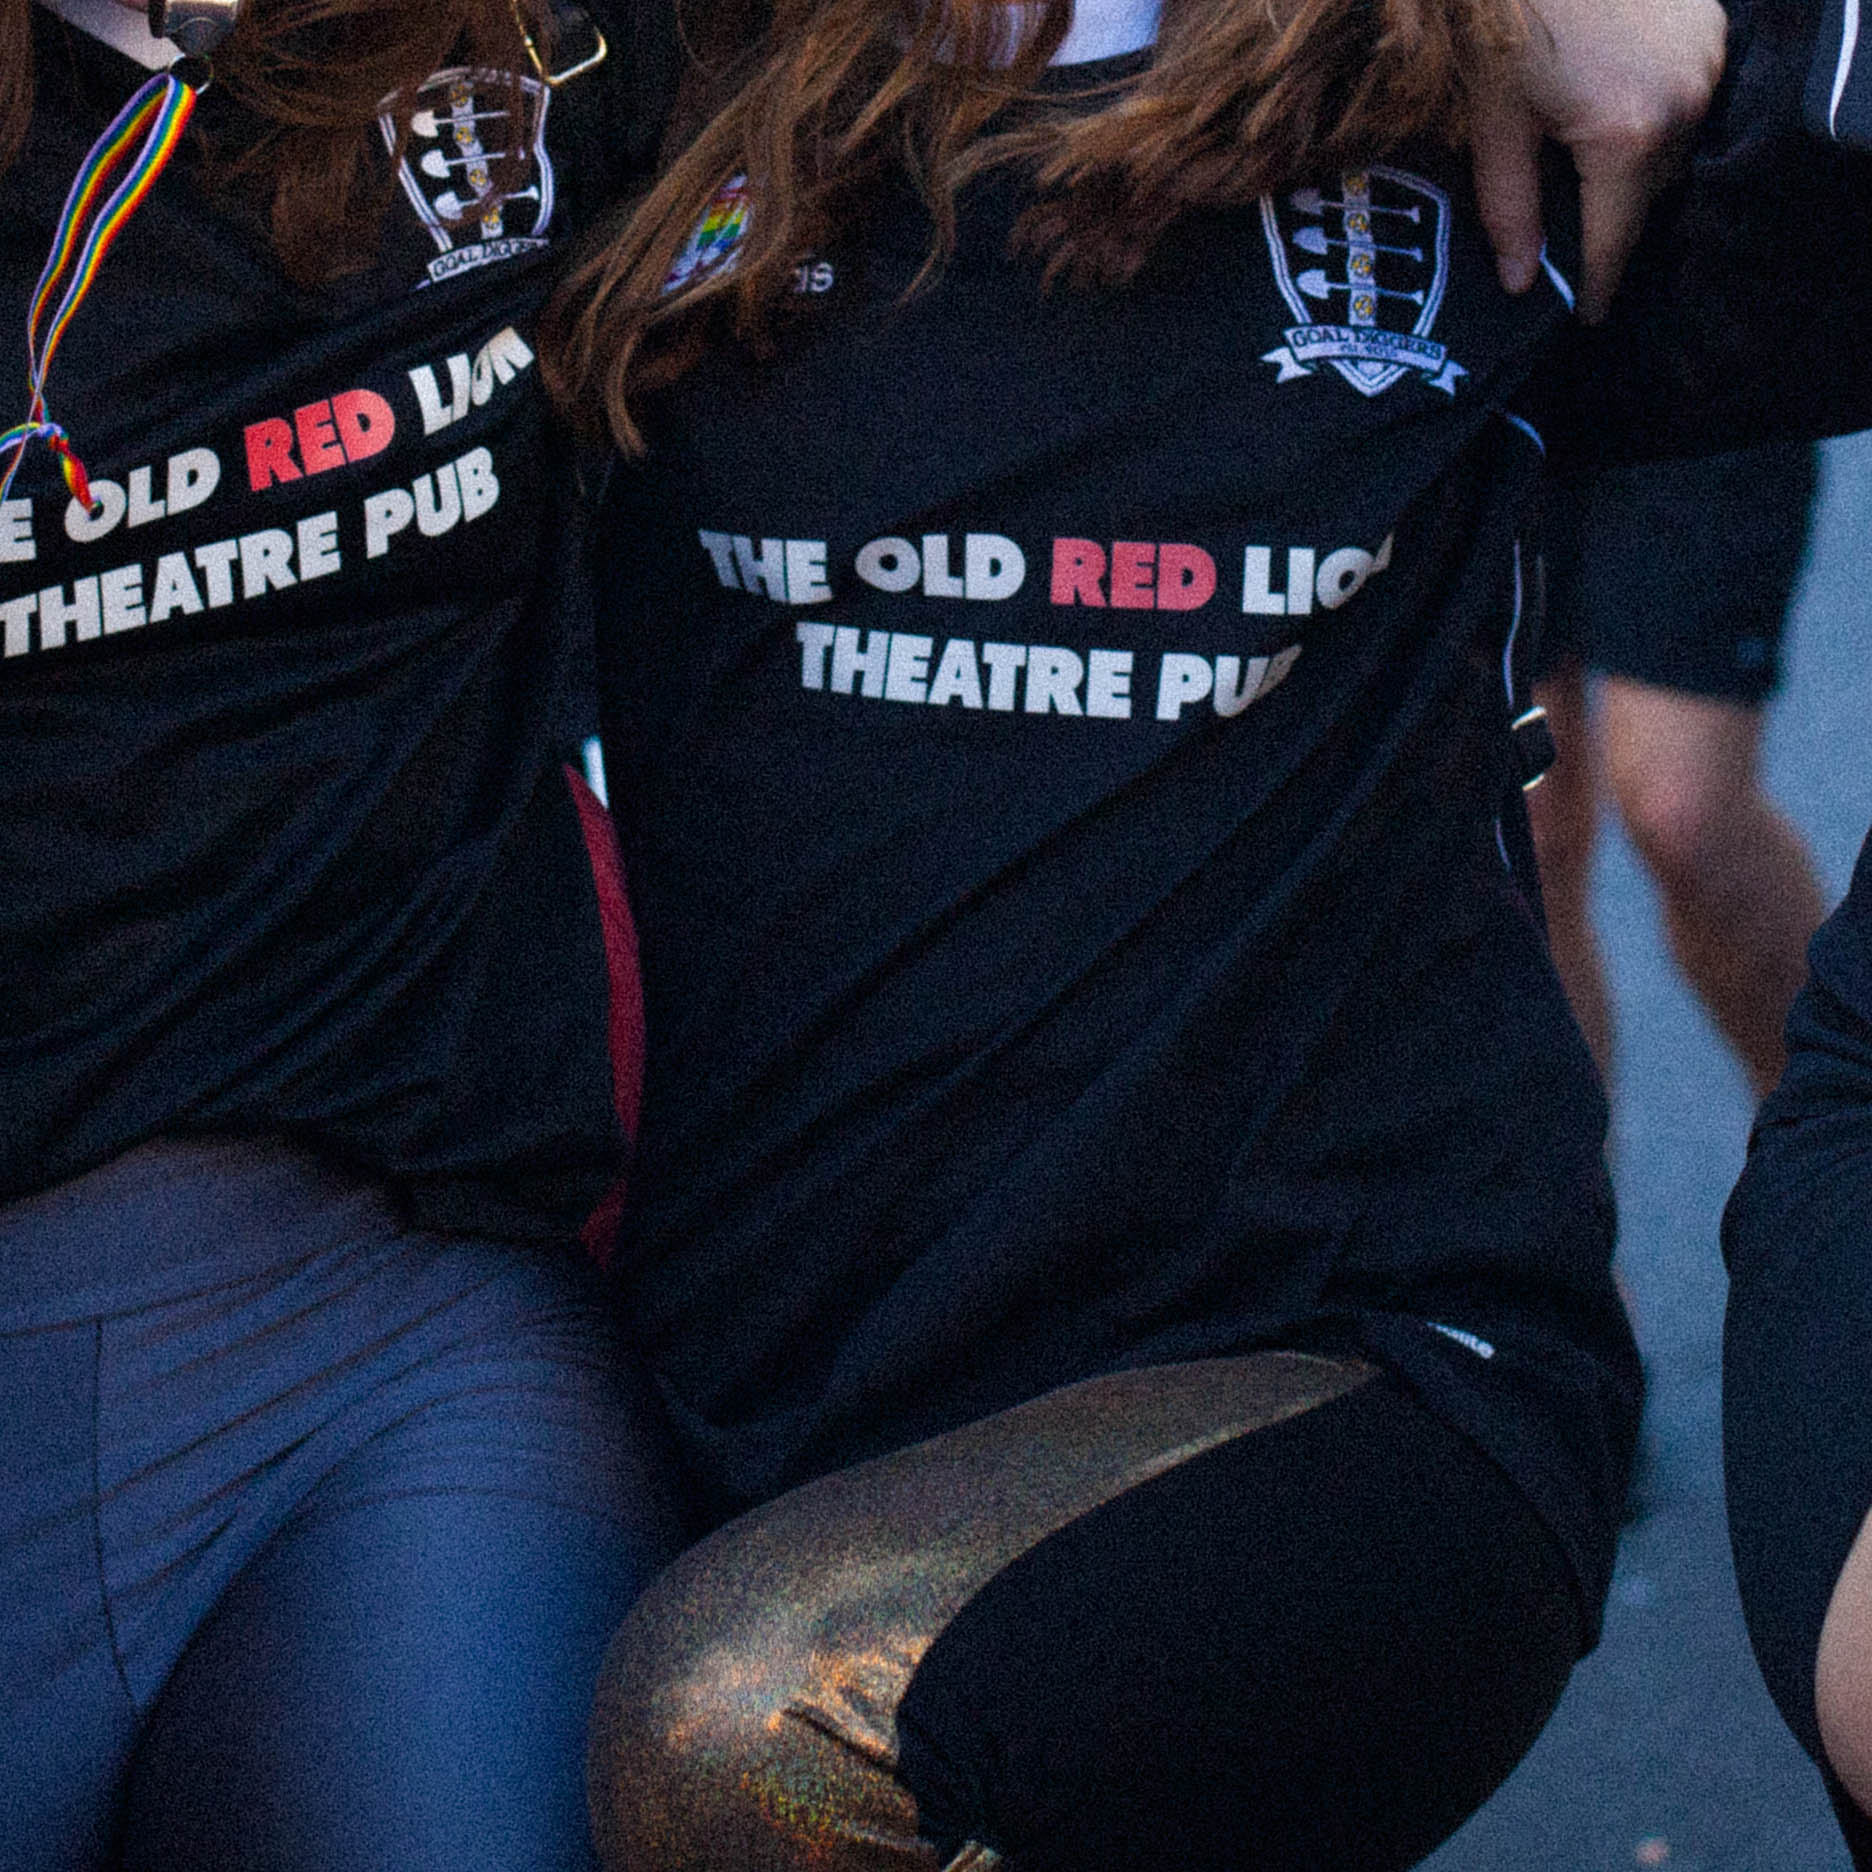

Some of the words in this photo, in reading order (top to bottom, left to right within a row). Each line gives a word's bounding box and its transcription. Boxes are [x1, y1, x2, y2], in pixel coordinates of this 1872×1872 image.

[1291, 327, 1350, 348] GOAL
[64, 448, 221, 544] OLD
[243, 388, 396, 492] RED
[408, 326, 535, 436] LION
[363, 446, 501, 559] PUB
[698, 529, 833, 605] THE
[855, 533, 1026, 601] OLD
[1050, 538, 1217, 611] RED
[796, 621, 1135, 720] THEATRE
